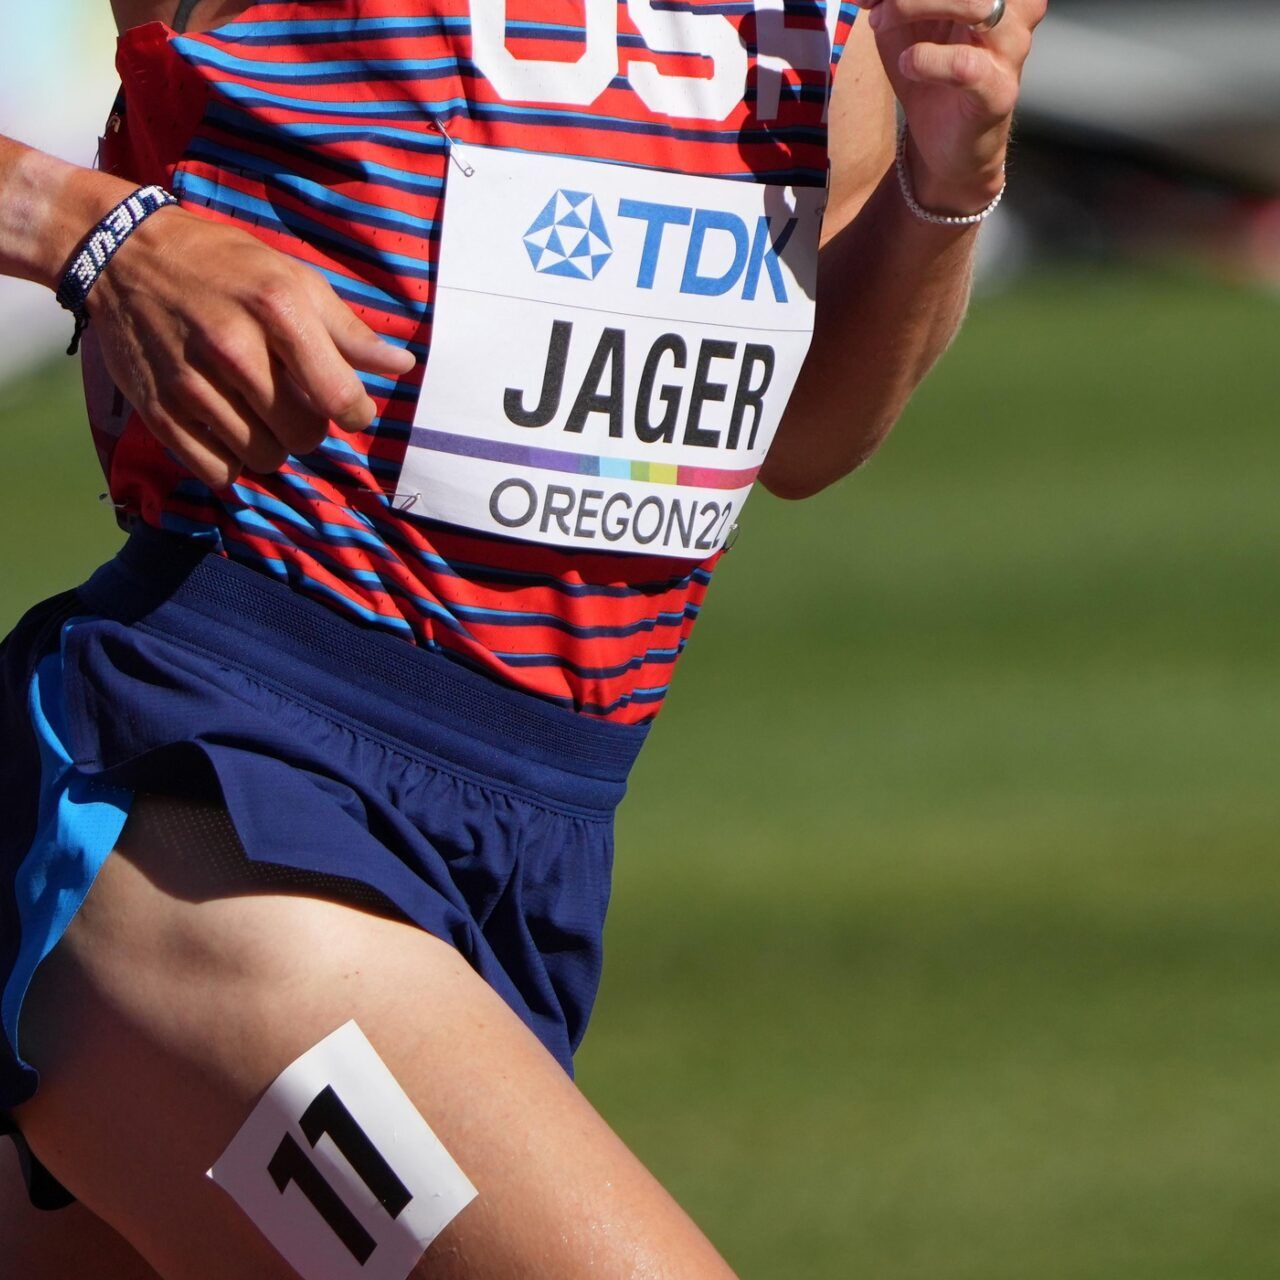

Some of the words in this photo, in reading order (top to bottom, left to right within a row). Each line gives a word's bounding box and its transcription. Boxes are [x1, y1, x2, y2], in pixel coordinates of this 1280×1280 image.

[617, 198, 799, 303] TDK
[503, 319, 776, 451] JAGER
[489, 477, 732, 549] OREGON22
[267, 1084, 413, 1266] 11
